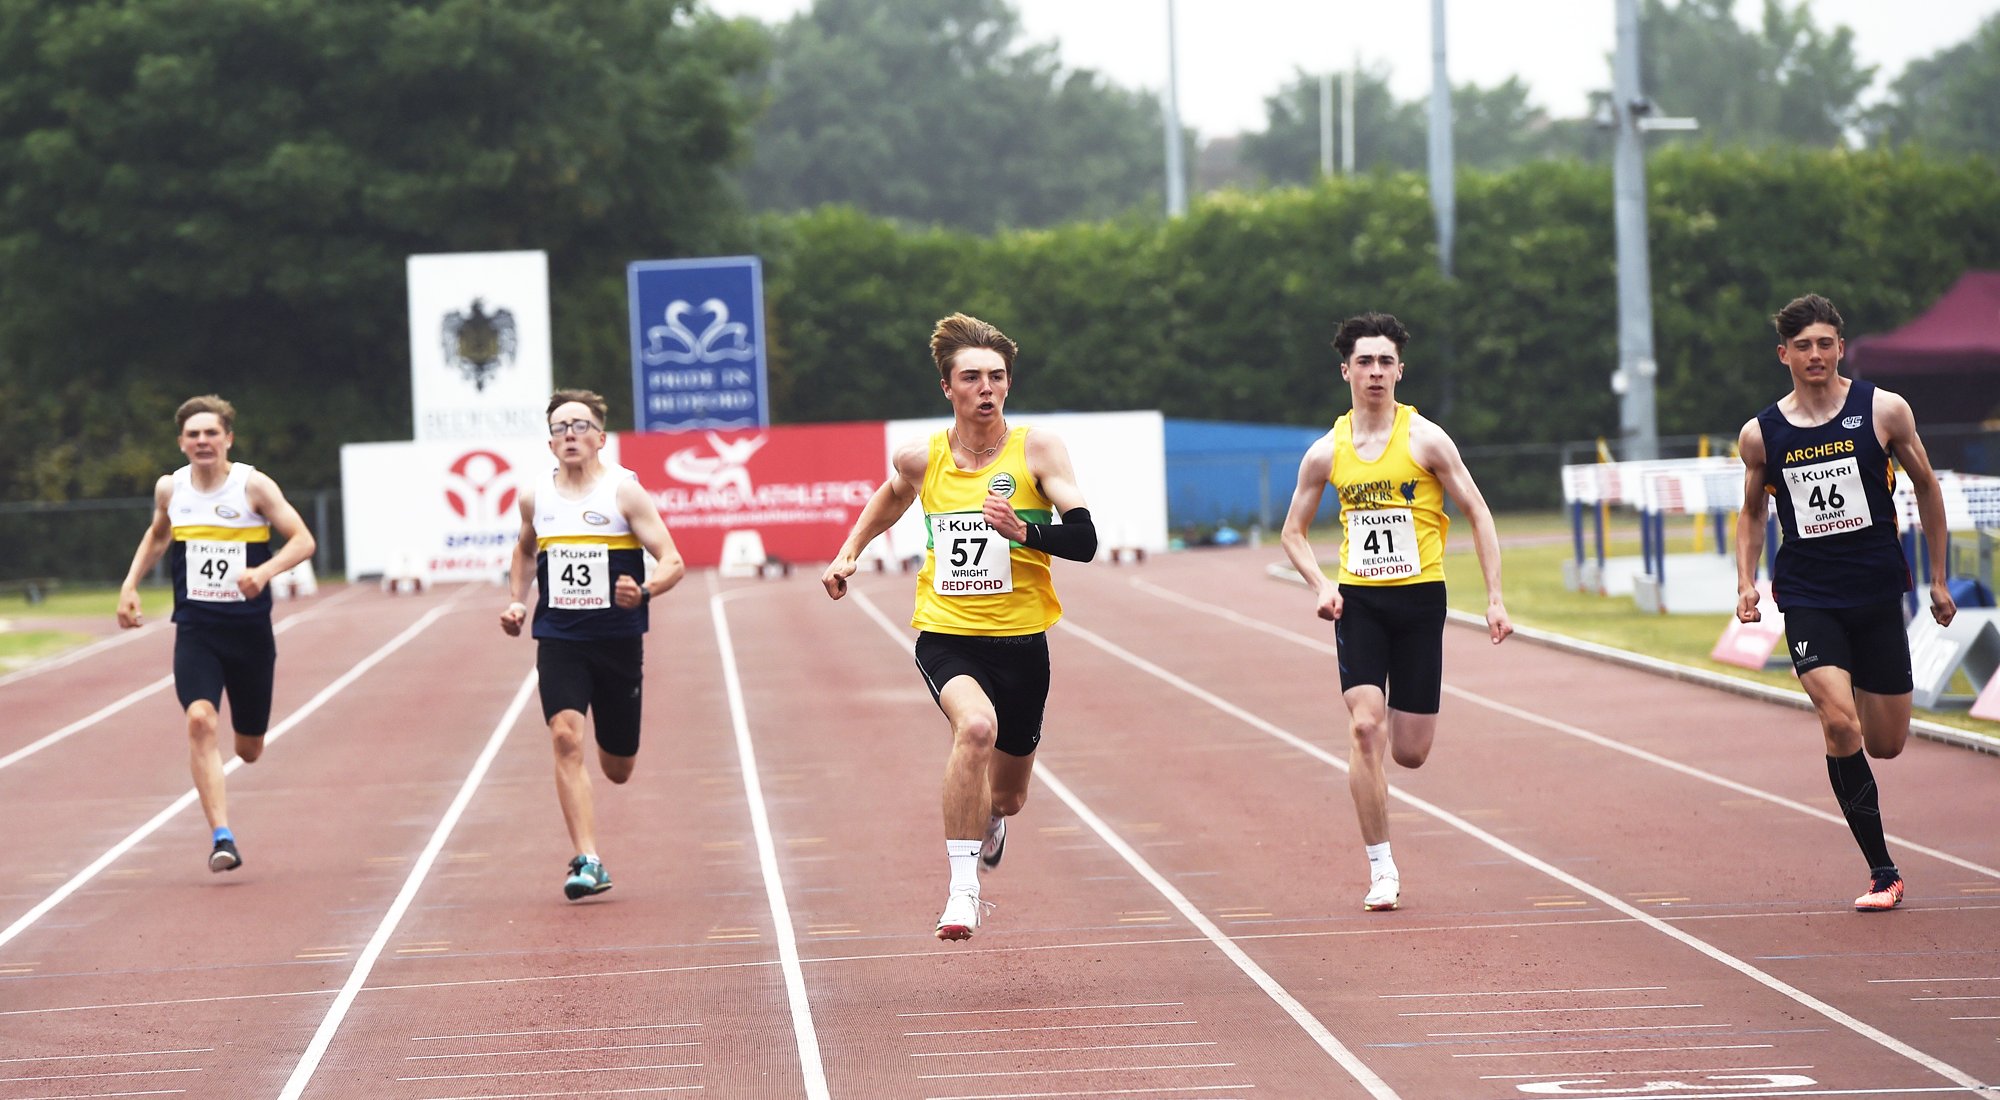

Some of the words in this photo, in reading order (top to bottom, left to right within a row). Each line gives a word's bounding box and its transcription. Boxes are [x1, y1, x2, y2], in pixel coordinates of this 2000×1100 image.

[1785, 440, 1854, 463] ARCHERS
[1802, 466, 1852, 482] KUKRI
[648, 489, 736, 512] NGLAND
[1809, 484, 1845, 511] 46
[1361, 514, 1407, 525] KUKRI
[1815, 510, 1846, 521] GRANT
[950, 520, 996, 531] KUKR
[1804, 517, 1864, 534] BEDFORD
[1363, 529, 1394, 554] 41
[560, 549, 602, 558] KUKRI
[950, 538, 988, 567] 57
[1362, 555, 1405, 565] BEECHALL
[200, 559, 229, 580] 49
[561, 563, 591, 587] 43
[951, 569, 989, 577] WRIGHT
[1355, 563, 1413, 577] BEDFORD
[941, 579, 1003, 591] BEDFORD
[554, 597, 604, 606] BEDFORD
